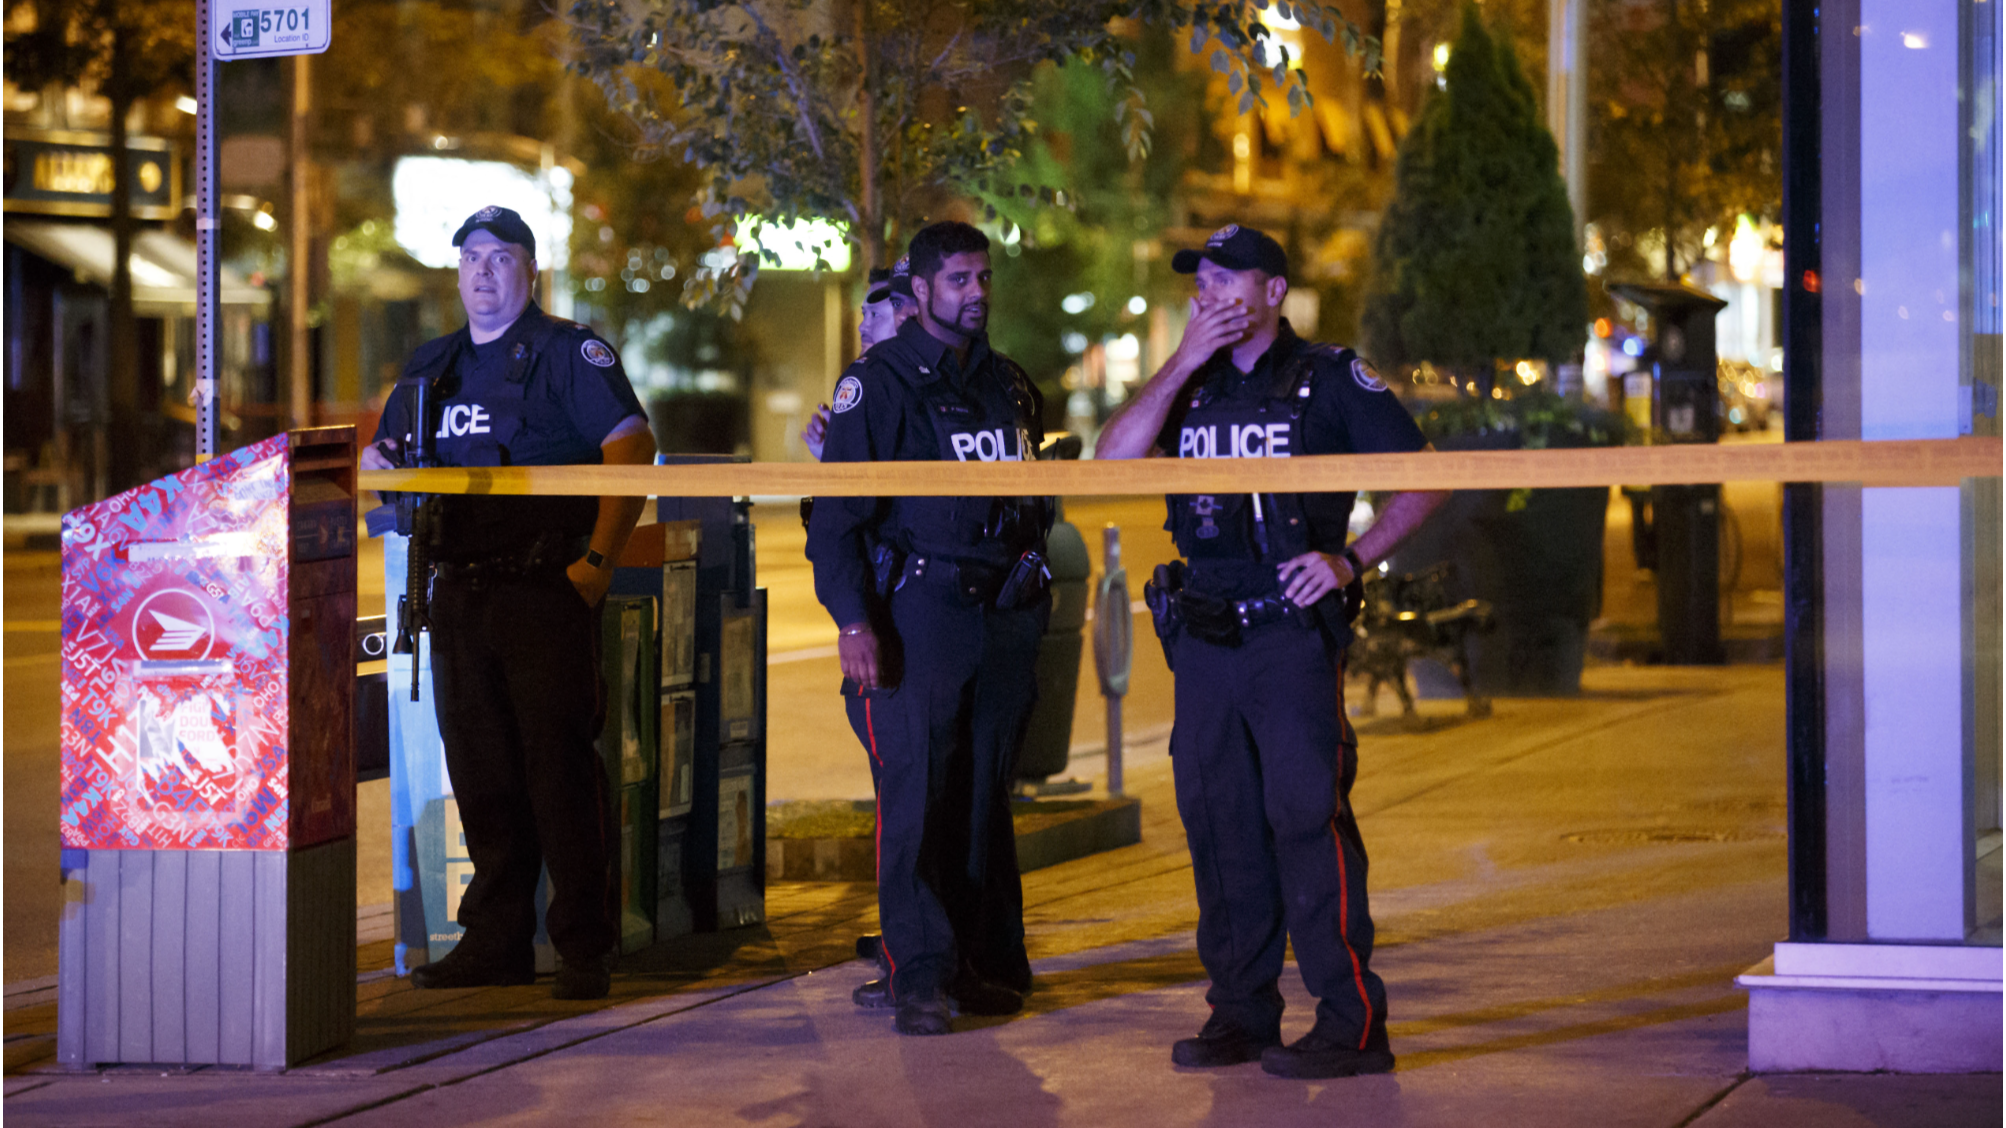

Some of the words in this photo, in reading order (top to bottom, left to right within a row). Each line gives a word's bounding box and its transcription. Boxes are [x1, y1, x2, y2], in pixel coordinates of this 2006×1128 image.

[260, 7, 309, 33] 5701
[274, 33, 300, 43] Location
[302, 33, 309, 41] ID
[436, 404, 490, 438] ICE
[1179, 424, 1291, 459] POLICE
[81, 549, 126, 593] V6K
[61, 573, 92, 613] X1A
[67, 648, 101, 677] J5T
[81, 687, 118, 729] T9K
[85, 760, 120, 800] T9K
[154, 769, 209, 825] B4E
[192, 777, 227, 806] J5T
[60, 786, 103, 827] K4A
[152, 801, 194, 844] G3N
[205, 815, 234, 848] T9K
